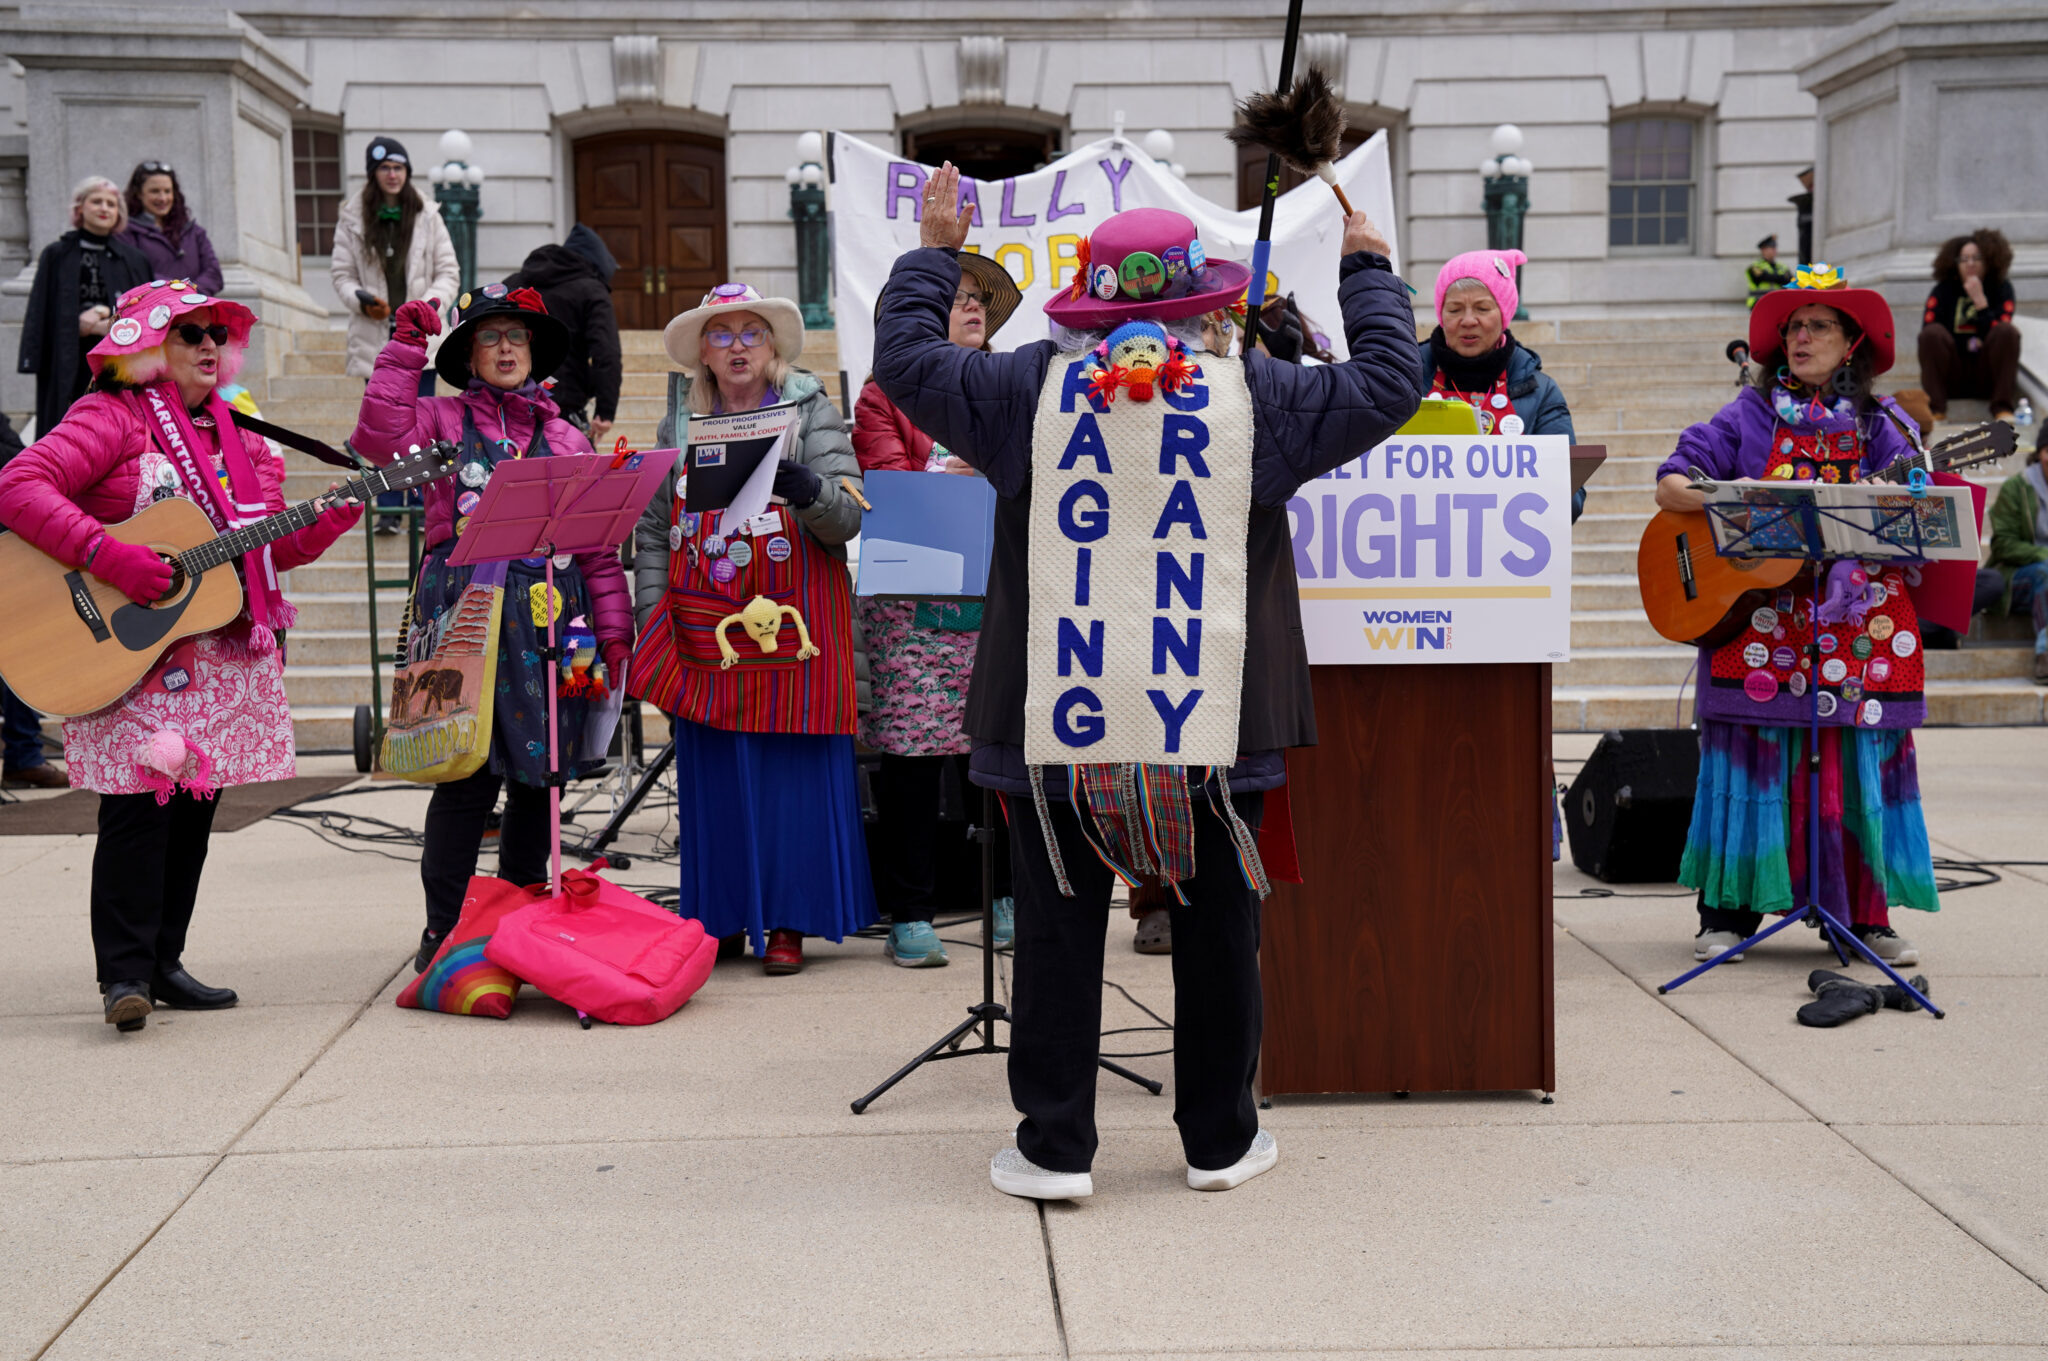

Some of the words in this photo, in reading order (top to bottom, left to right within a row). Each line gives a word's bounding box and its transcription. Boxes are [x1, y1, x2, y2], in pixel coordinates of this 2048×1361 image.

[702, 418, 730, 427] PROUD
[731, 409, 787, 424] PROGRESSIVES
[732, 423, 757, 431] VALUE
[1385, 444, 1455, 480] FOR
[1465, 444, 1539, 479] OUR
[1285, 491, 1552, 580] RIGHTS
[1053, 359, 1113, 748] RAGING
[1146, 358, 1211, 753] GRANNY
[1362, 610, 1452, 624] WOMEN
[1363, 627, 1445, 650] WIN
